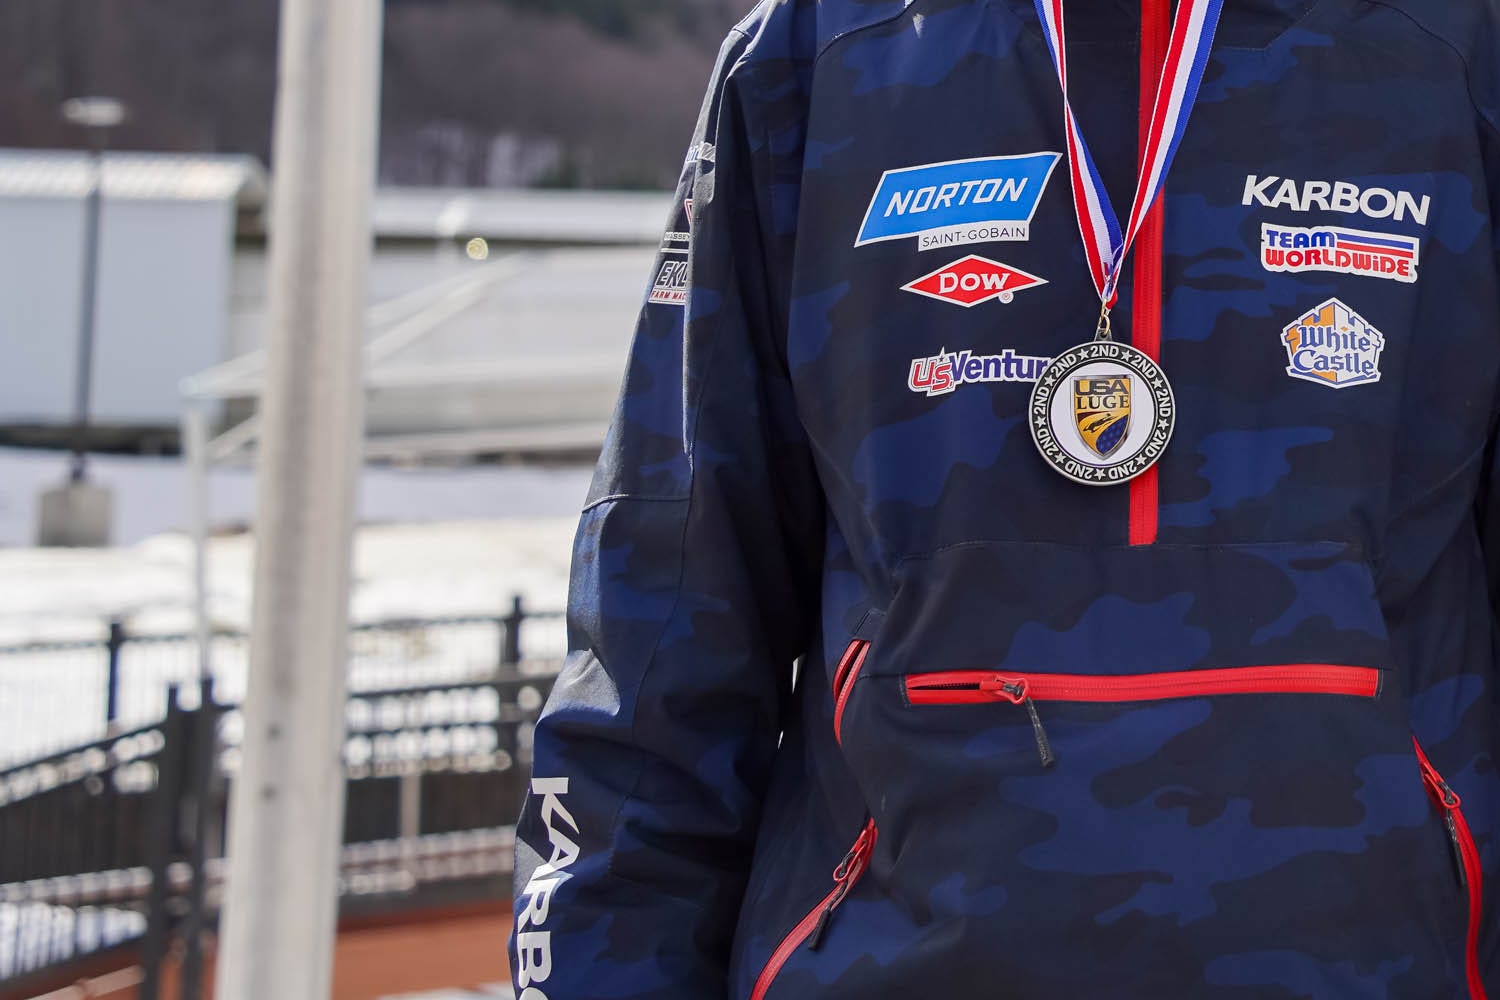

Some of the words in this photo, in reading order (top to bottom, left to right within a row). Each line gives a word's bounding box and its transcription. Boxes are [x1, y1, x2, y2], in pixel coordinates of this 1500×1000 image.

[884, 177, 1029, 217] NORTON
[1241, 174, 1431, 226] KARBON
[922, 226, 1027, 248] SAINT-GOBAIN
[1266, 229, 1335, 249] TEAM
[939, 272, 1010, 294] DOW
[1090, 345, 1119, 358] 2ND
[1297, 325, 1371, 352] White
[951, 351, 1049, 383] Ventur
[1051, 353, 1077, 374] 2ND
[1131, 354, 1158, 380] 2ND
[1293, 349, 1375, 375] Castle
[1033, 386, 1049, 414] 2ND
[1075, 379, 1129, 395] USA
[1076, 395, 1130, 409] LUGE
[1156, 388, 1171, 418] 2ND
[1037, 428, 1059, 456] 2ND
[1144, 431, 1167, 459] 2ND
[1064, 461, 1092, 480] 2ND
[1108, 462, 1138, 480] 2ND
